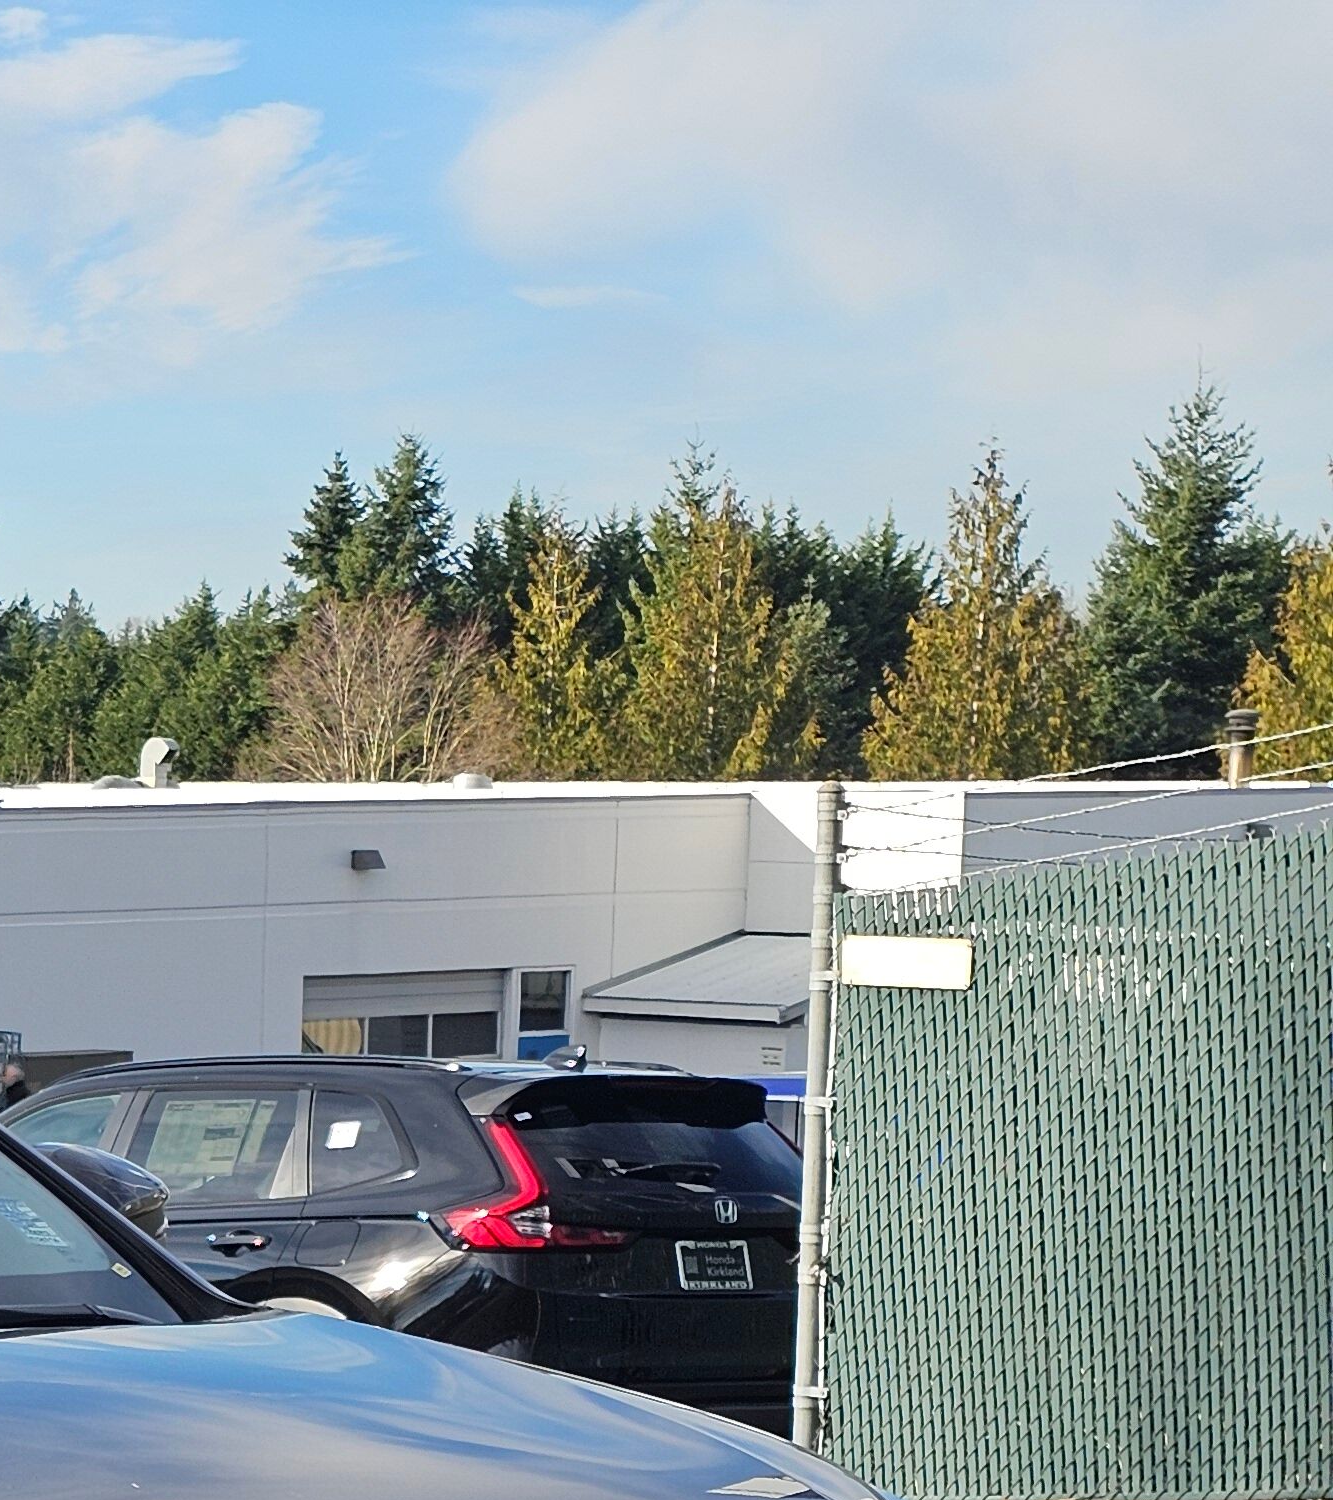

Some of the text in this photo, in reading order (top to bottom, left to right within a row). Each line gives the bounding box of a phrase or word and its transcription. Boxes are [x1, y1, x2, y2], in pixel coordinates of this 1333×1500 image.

[696, 1241, 729, 1249] HONDA
[704, 1254, 736, 1265] Honda
[706, 1266, 745, 1278] Kirkland
[688, 1281, 748, 1289] KIRKLAND
